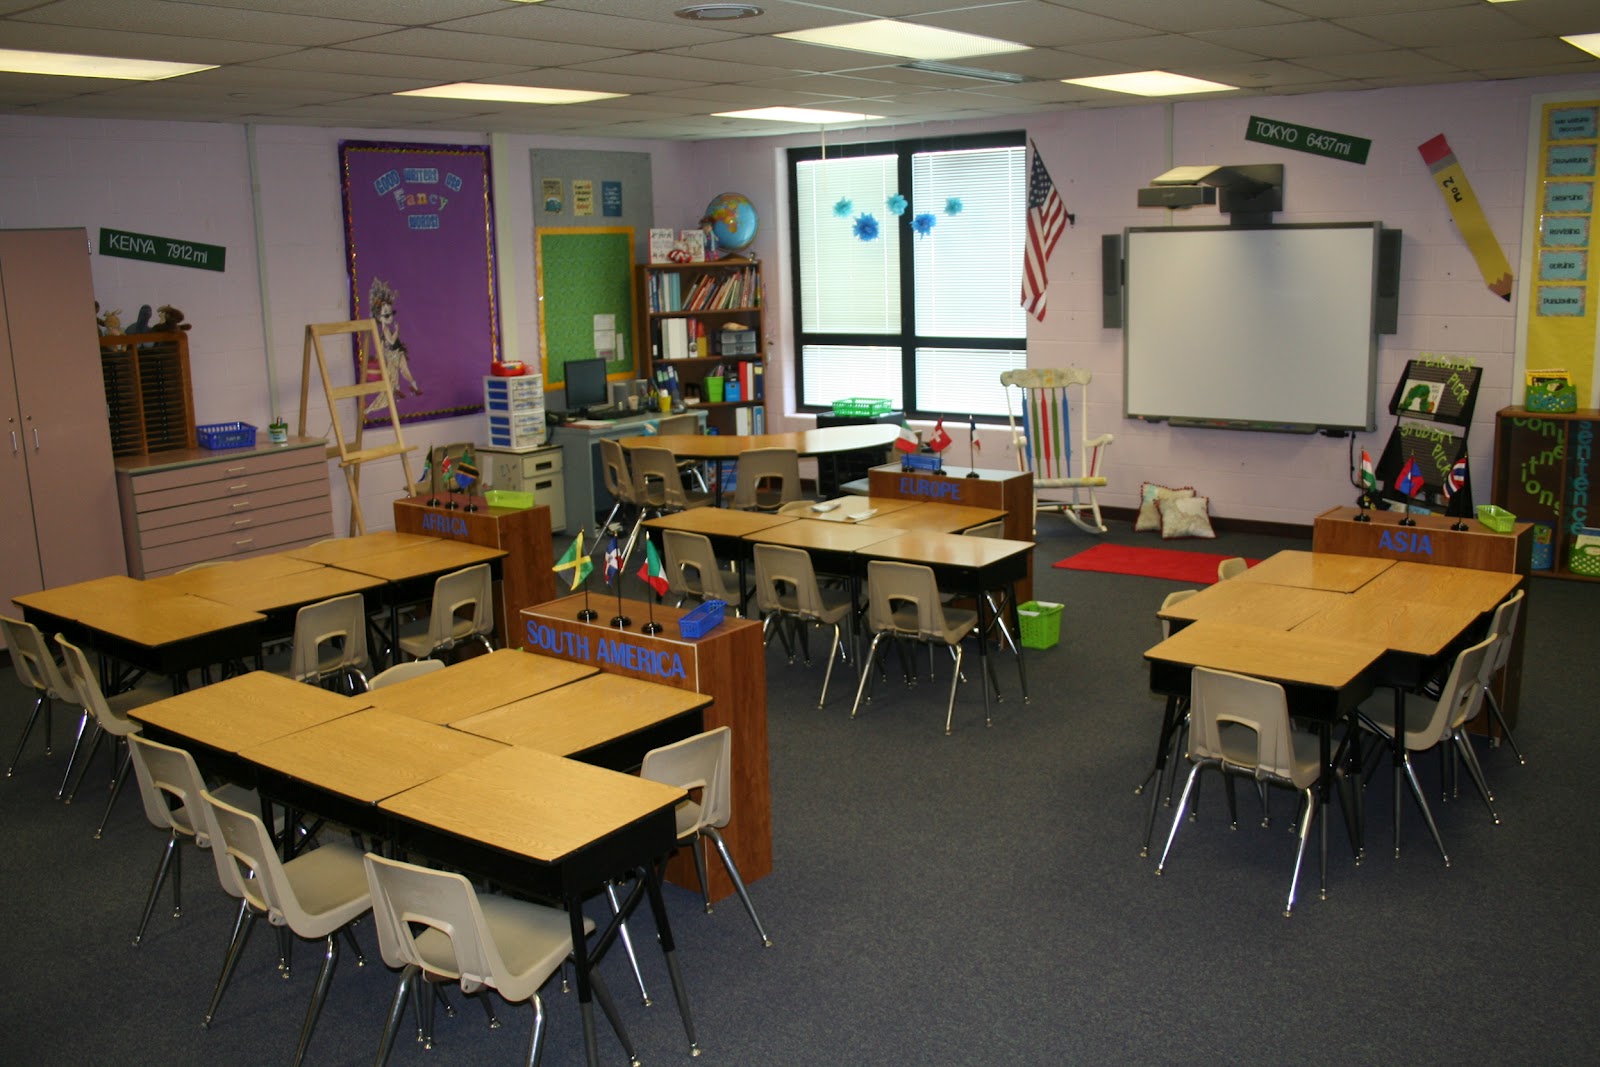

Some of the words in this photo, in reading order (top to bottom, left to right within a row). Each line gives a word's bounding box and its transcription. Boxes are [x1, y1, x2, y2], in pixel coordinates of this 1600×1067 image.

[1256, 121, 1298, 143] TOKYO
[375, 170, 400, 195] GOOD
[1442, 176, 1454, 188] 2
[393, 188, 448, 211] Fancy
[109, 233, 156, 255] KENYA
[1400, 422, 1454, 444] STUDENT
[1431, 443, 1452, 480] PICK
[900, 477, 962, 500] EUROPE
[422, 513, 468, 537] AFRICA
[1378, 529, 1433, 555] ASIA
[526, 619, 590, 661] SOUTH
[596, 637, 687, 679] AMERICA
